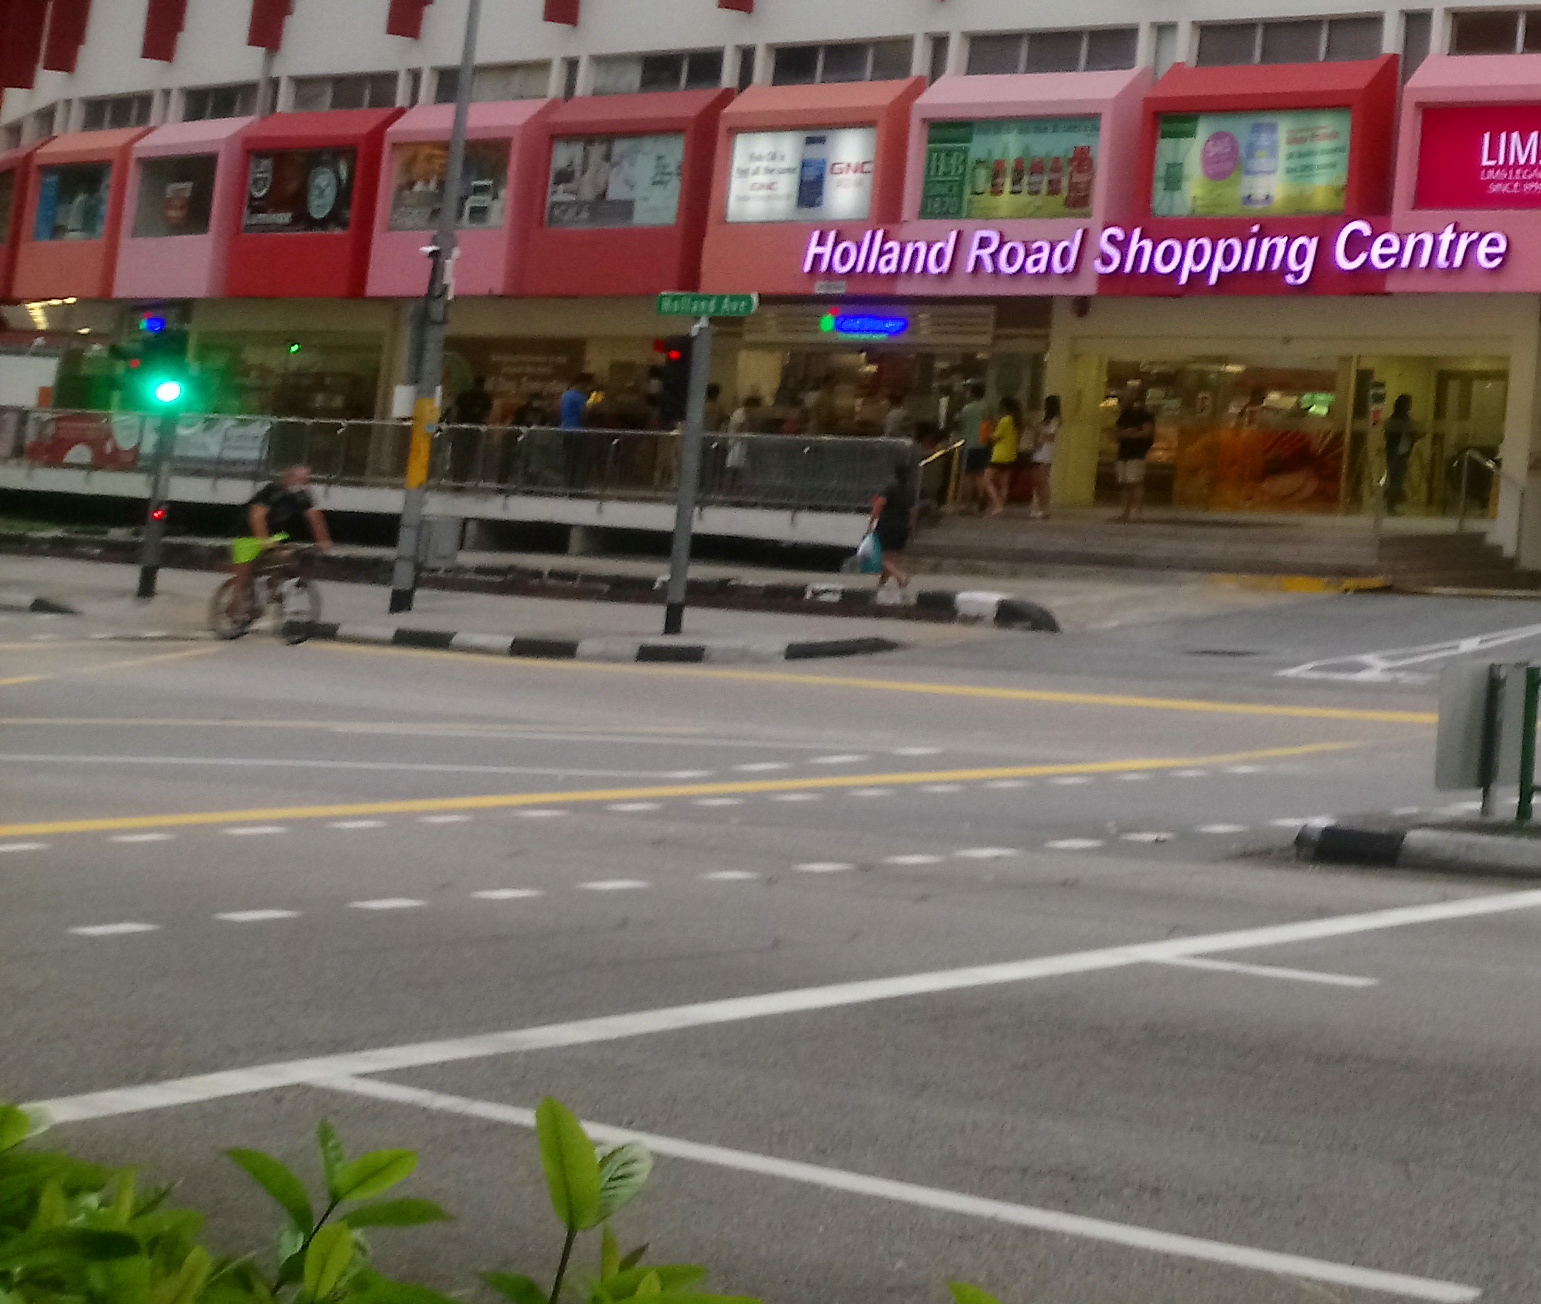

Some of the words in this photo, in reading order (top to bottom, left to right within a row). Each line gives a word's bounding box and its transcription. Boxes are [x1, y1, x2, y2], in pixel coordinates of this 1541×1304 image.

[829, 160, 874, 176] GNC
[1487, 181, 1521, 194] SINCE
[803, 228, 961, 275] Holland
[965, 227, 1086, 275] Road
[1094, 224, 1320, 286] Shopping
[1335, 219, 1509, 271] Centre
